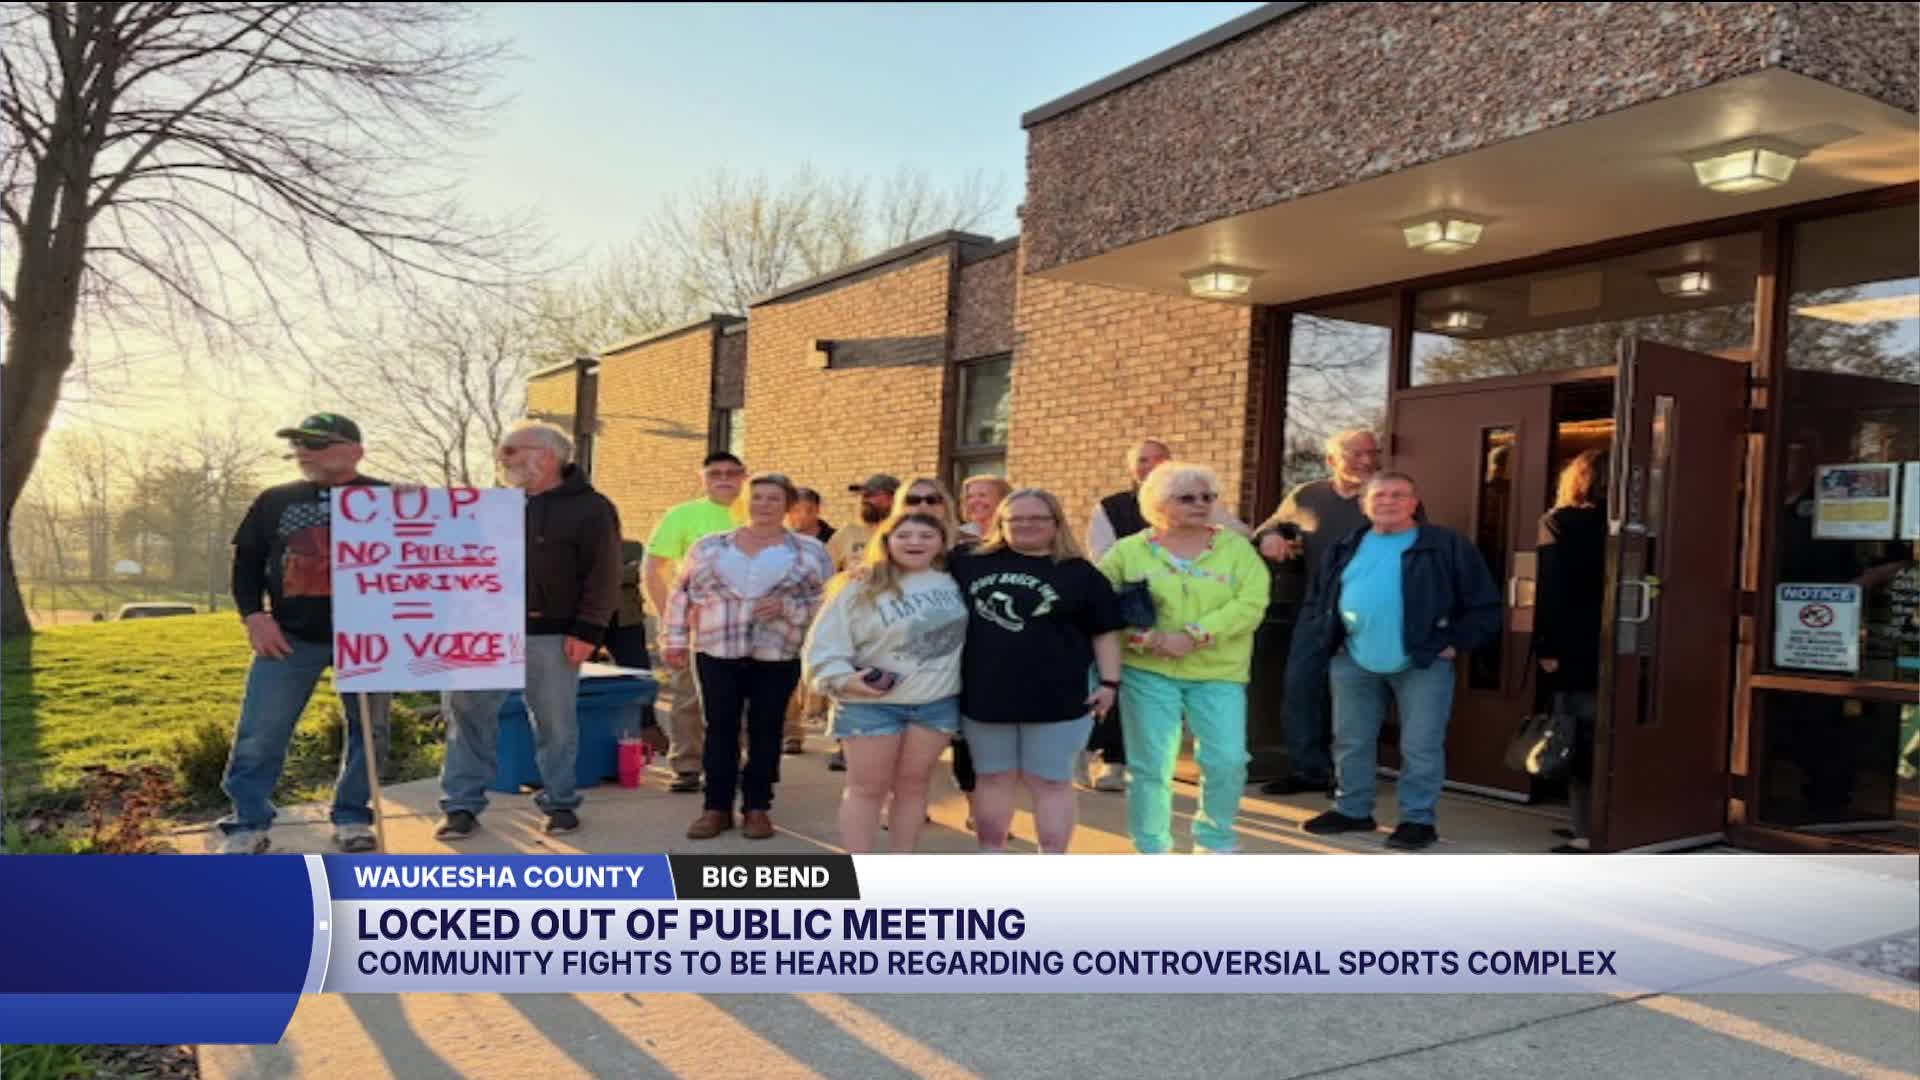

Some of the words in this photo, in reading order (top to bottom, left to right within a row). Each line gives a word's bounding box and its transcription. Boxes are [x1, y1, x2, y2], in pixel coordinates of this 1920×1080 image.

[336, 540, 392, 566] NO
[400, 541, 498, 563] PUBLIC
[356, 571, 504, 595] HEARINGS
[1784, 587, 1856, 602] NOTICE
[335, 631, 389, 671] NO
